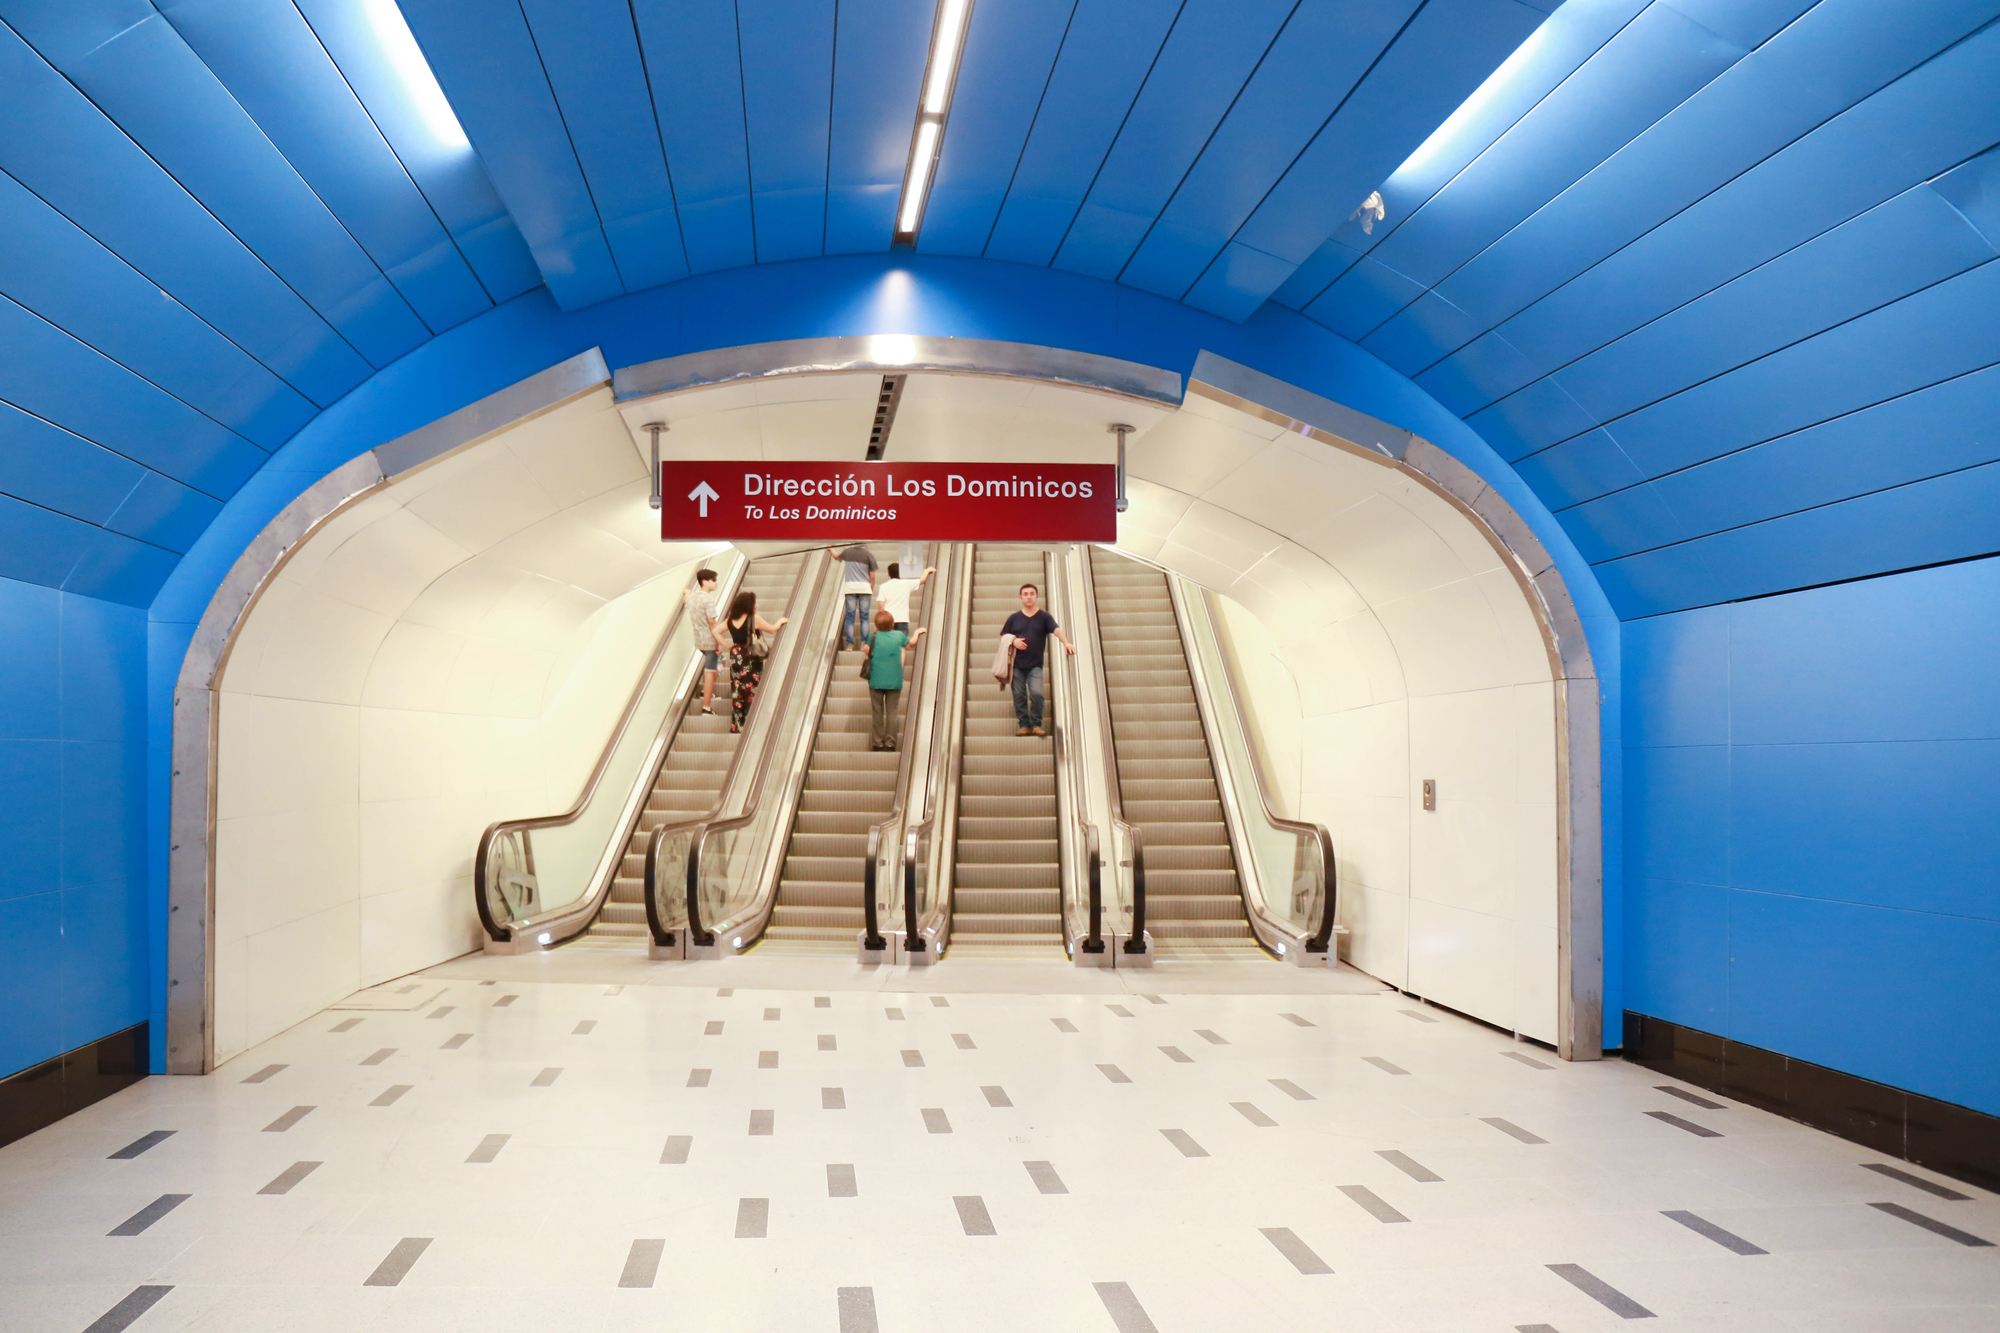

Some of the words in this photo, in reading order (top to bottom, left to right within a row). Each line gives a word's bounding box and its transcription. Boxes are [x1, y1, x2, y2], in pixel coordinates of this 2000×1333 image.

[744, 473, 876, 497] Dirección
[887, 474, 936, 497] Los
[947, 474, 1093, 499] Dominicos
[744, 505, 764, 520] To
[769, 505, 800, 520] Los
[805, 505, 897, 520] Dominicos
